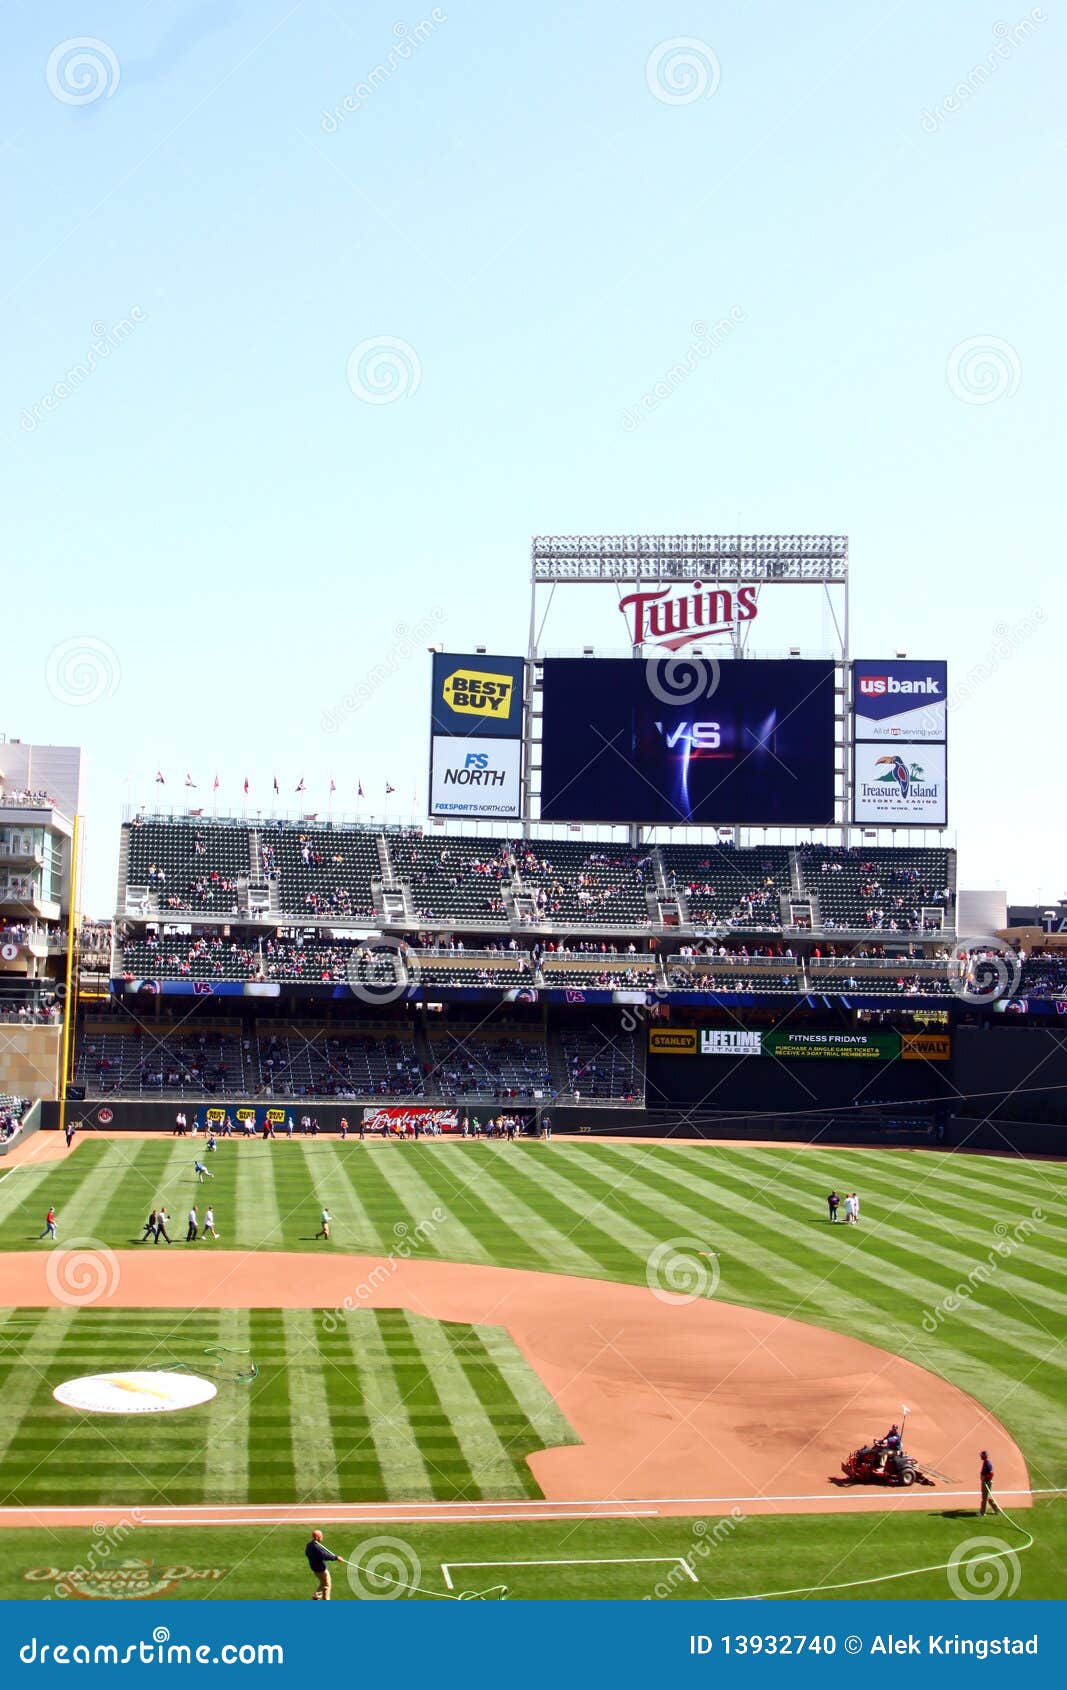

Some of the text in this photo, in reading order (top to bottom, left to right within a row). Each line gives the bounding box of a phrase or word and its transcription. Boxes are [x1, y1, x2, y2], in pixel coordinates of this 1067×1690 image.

[619, 580, 757, 647] Twins
[452, 677, 510, 697] BEST
[453, 692, 503, 711] BUY
[655, 722, 720, 748] VS
[464, 753, 488, 769] FS
[444, 769, 505, 787] NORTH
[861, 783, 938, 797] Treasure Island
[654, 1036, 691, 1046] STANLEY
[701, 1030, 762, 1047] LIFETIME
[828, 1035, 867, 1043] FRIDAYS
